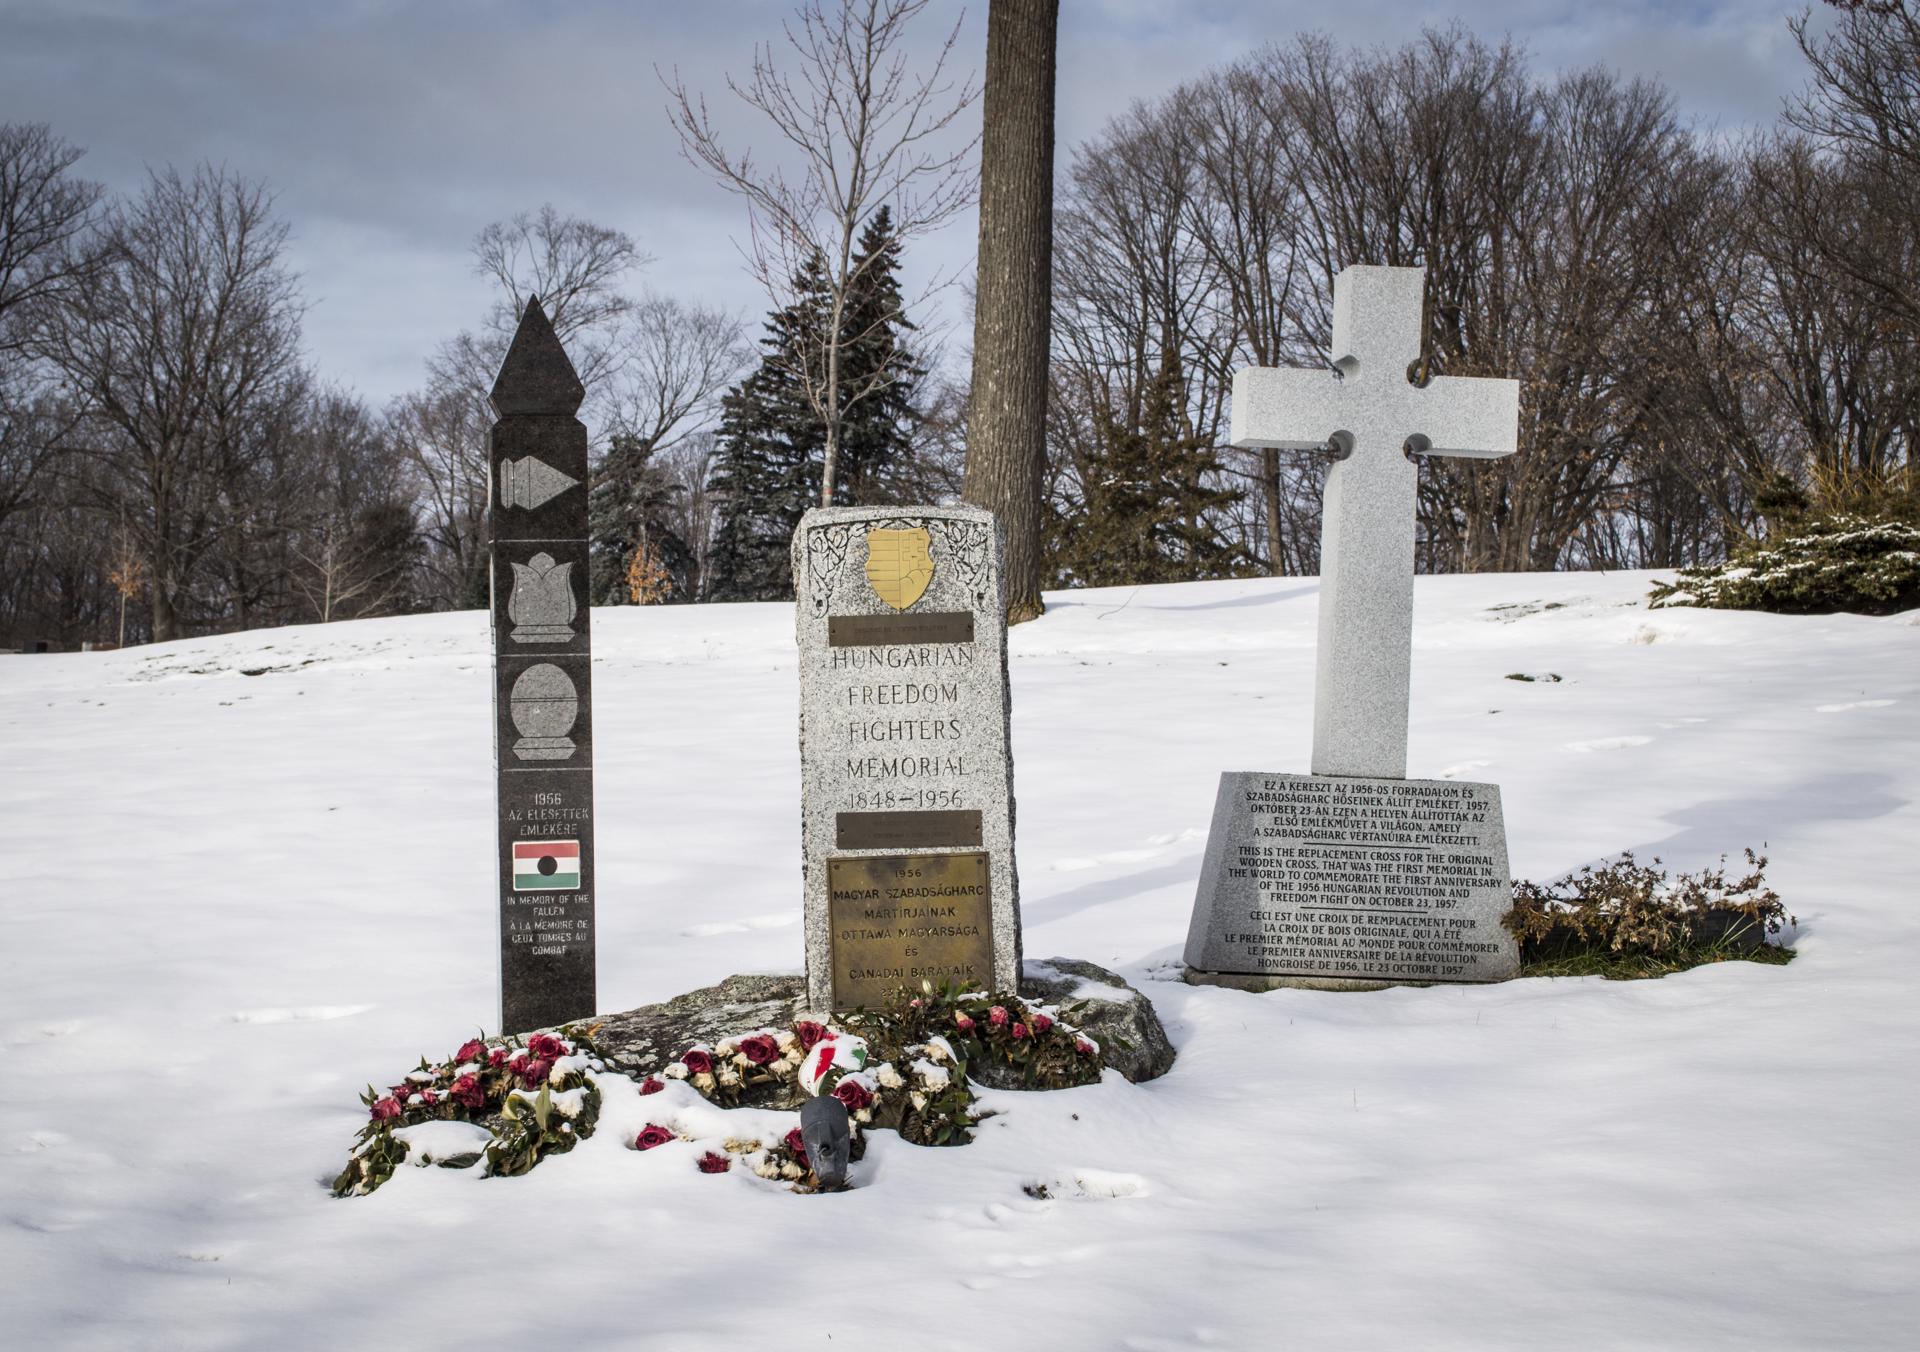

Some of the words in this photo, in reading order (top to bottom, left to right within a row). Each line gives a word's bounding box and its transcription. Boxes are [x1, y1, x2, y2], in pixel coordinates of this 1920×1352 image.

[834, 647, 973, 669] HUNGARIAN
[849, 683, 958, 705] FREEDOM
[850, 720, 961, 742] FIGHTERS
[848, 756, 969, 778] MEMORIAL
[1264, 781, 1276, 790] EZ
[1280, 782, 1286, 790] A
[1289, 782, 1332, 792] KERESZT
[1334, 784, 1347, 793] AZ
[1351, 784, 1388, 794] 1956-OS
[1392, 786, 1458, 798] FORRADALOM
[1462, 788, 1474, 798] ÉS
[535, 793, 562, 806] 1956
[1246, 792, 1330, 804] SZABADSÁGHARC
[1333, 792, 1383, 806] HŐSEINEK
[1386, 796, 1412, 808] ÁLLÍT
[508, 809, 522, 820] AZ
[1251, 802, 1296, 814] OKTÓBER
[1300, 804, 1328, 816] 23-ÁN
[1332, 808, 1357, 816] EZEN
[1361, 809, 1367, 817] A
[1370, 809, 1408, 820] HELYEN
[1411, 810, 1469, 821] ÁLLÍTOTTÁK
[1472, 814, 1484, 822] AZ
[1274, 814, 1298, 826] ELSŐ
[1302, 816, 1368, 829] EMLÉKMŰVET
[1370, 821, 1377, 829] A
[1380, 820, 1426, 832] VILÁGON,
[1428, 823, 1461, 833] AMELY
[1254, 828, 1260, 836] A
[1264, 828, 1348, 840] SZABADSÁGHARC
[1350, 830, 1412, 842] VÉRTANÚIRA
[1416, 834, 1480, 846] EMLÉKEZETT.
[1238, 846, 1260, 856] THIS
[1264, 848, 1272, 856] IS
[1276, 848, 1294, 857] THE
[1298, 848, 1368, 860] REPLACEMENT
[1370, 852, 1400, 862] CROSS
[1404, 853, 1422, 862] FOR
[1426, 854, 1444, 864] THE
[1448, 855, 1494, 866] ORIGINAL
[895, 870, 922, 878] 1956
[1240, 858, 1282, 868] WOODEN
[1323, 861, 1348, 870] THAT
[1350, 862, 1371, 872] WAS
[1374, 863, 1394, 872] THE
[1397, 864, 1424, 874] FIRST
[1426, 865, 1478, 876] MEMORIAL
[1482, 868, 1492, 876] IN
[1228, 868, 1247, 878] THE
[1250, 868, 1284, 879] WORLD
[1288, 870, 1300, 879] TO
[1304, 871, 1379, 883] COMMEMORATE
[1382, 875, 1401, 884] THE
[1405, 876, 1432, 885] FIRST
[1434, 877, 1502, 888] ANNIVERSARY
[834, 889, 879, 900] MAGYAR
[886, 884, 984, 898] SZABADSÁGHARC
[1260, 881, 1273, 890] OF
[1276, 882, 1294, 890] THE
[1298, 882, 1320, 892] 1956
[1323, 884, 1380, 894] HUNGARIAN
[1385, 886, 1446, 897] REVOLUTION
[1448, 889, 1470, 898] AND
[507, 896, 516, 904] IN
[520, 895, 554, 904] MEMORY
[560, 895, 570, 904] OF
[574, 894, 589, 904] THE
[1270, 892, 1317, 903] FREEDOM
[1320, 894, 1349, 904] FIGHT
[1352, 896, 1366, 905] ON
[1369, 897, 1414, 907] OCTOBER
[534, 907, 564, 916] FALLEN
[1250, 911, 1271, 920] CECI
[1274, 912, 1292, 921] EST
[1295, 913, 1316, 922] UNE
[1318, 914, 1348, 924] CROIX
[1352, 915, 1364, 924] DE
[1368, 916, 1446, 928] REMPLACEMENT
[1449, 919, 1476, 928] POUR
[520, 922, 530, 930] LA
[577, 920, 588, 929] DE
[842, 929, 892, 940] OTTAWA
[899, 924, 979, 938] MAGYARSÁGA
[1264, 924, 1276, 932] LA
[1279, 924, 1308, 934] CROIX
[1312, 926, 1324, 934] DE
[1328, 926, 1350, 936] BOIS
[1354, 926, 1409, 938] ORIGINALE,
[1412, 929, 1430, 940] QUI
[1434, 930, 1440, 938] A
[1444, 928, 1462, 940] ÉTÉ
[512, 934, 533, 943] CEUX
[576, 932, 586, 941] AU
[1225, 934, 1236, 942] LE
[1240, 934, 1282, 944] PREMIER
[1286, 933, 1338, 946] MÉMORIAL
[1342, 938, 1355, 947] AU
[1359, 940, 1394, 949] MONDE
[1398, 940, 1425, 950] POUR
[1428, 940, 1499, 953] COMMÉMORER
[532, 946, 567, 955] COMBAT
[905, 945, 918, 956] ÉS
[1248, 946, 1258, 955] LE
[1262, 947, 1305, 957] PREMIER
[1308, 949, 1380, 960] ANNIVERSAIRE
[1384, 952, 1398, 960] DE
[1400, 952, 1412, 961] LA
[1416, 951, 1476, 964] RÉVOLUTION
[1258, 958, 1314, 970] HONGROISE
[1318, 961, 1330, 970] DE
[1364, 962, 1374, 971] LE
[1378, 963, 1389, 972] 23
[1393, 964, 1438, 974] OCTOBRE
